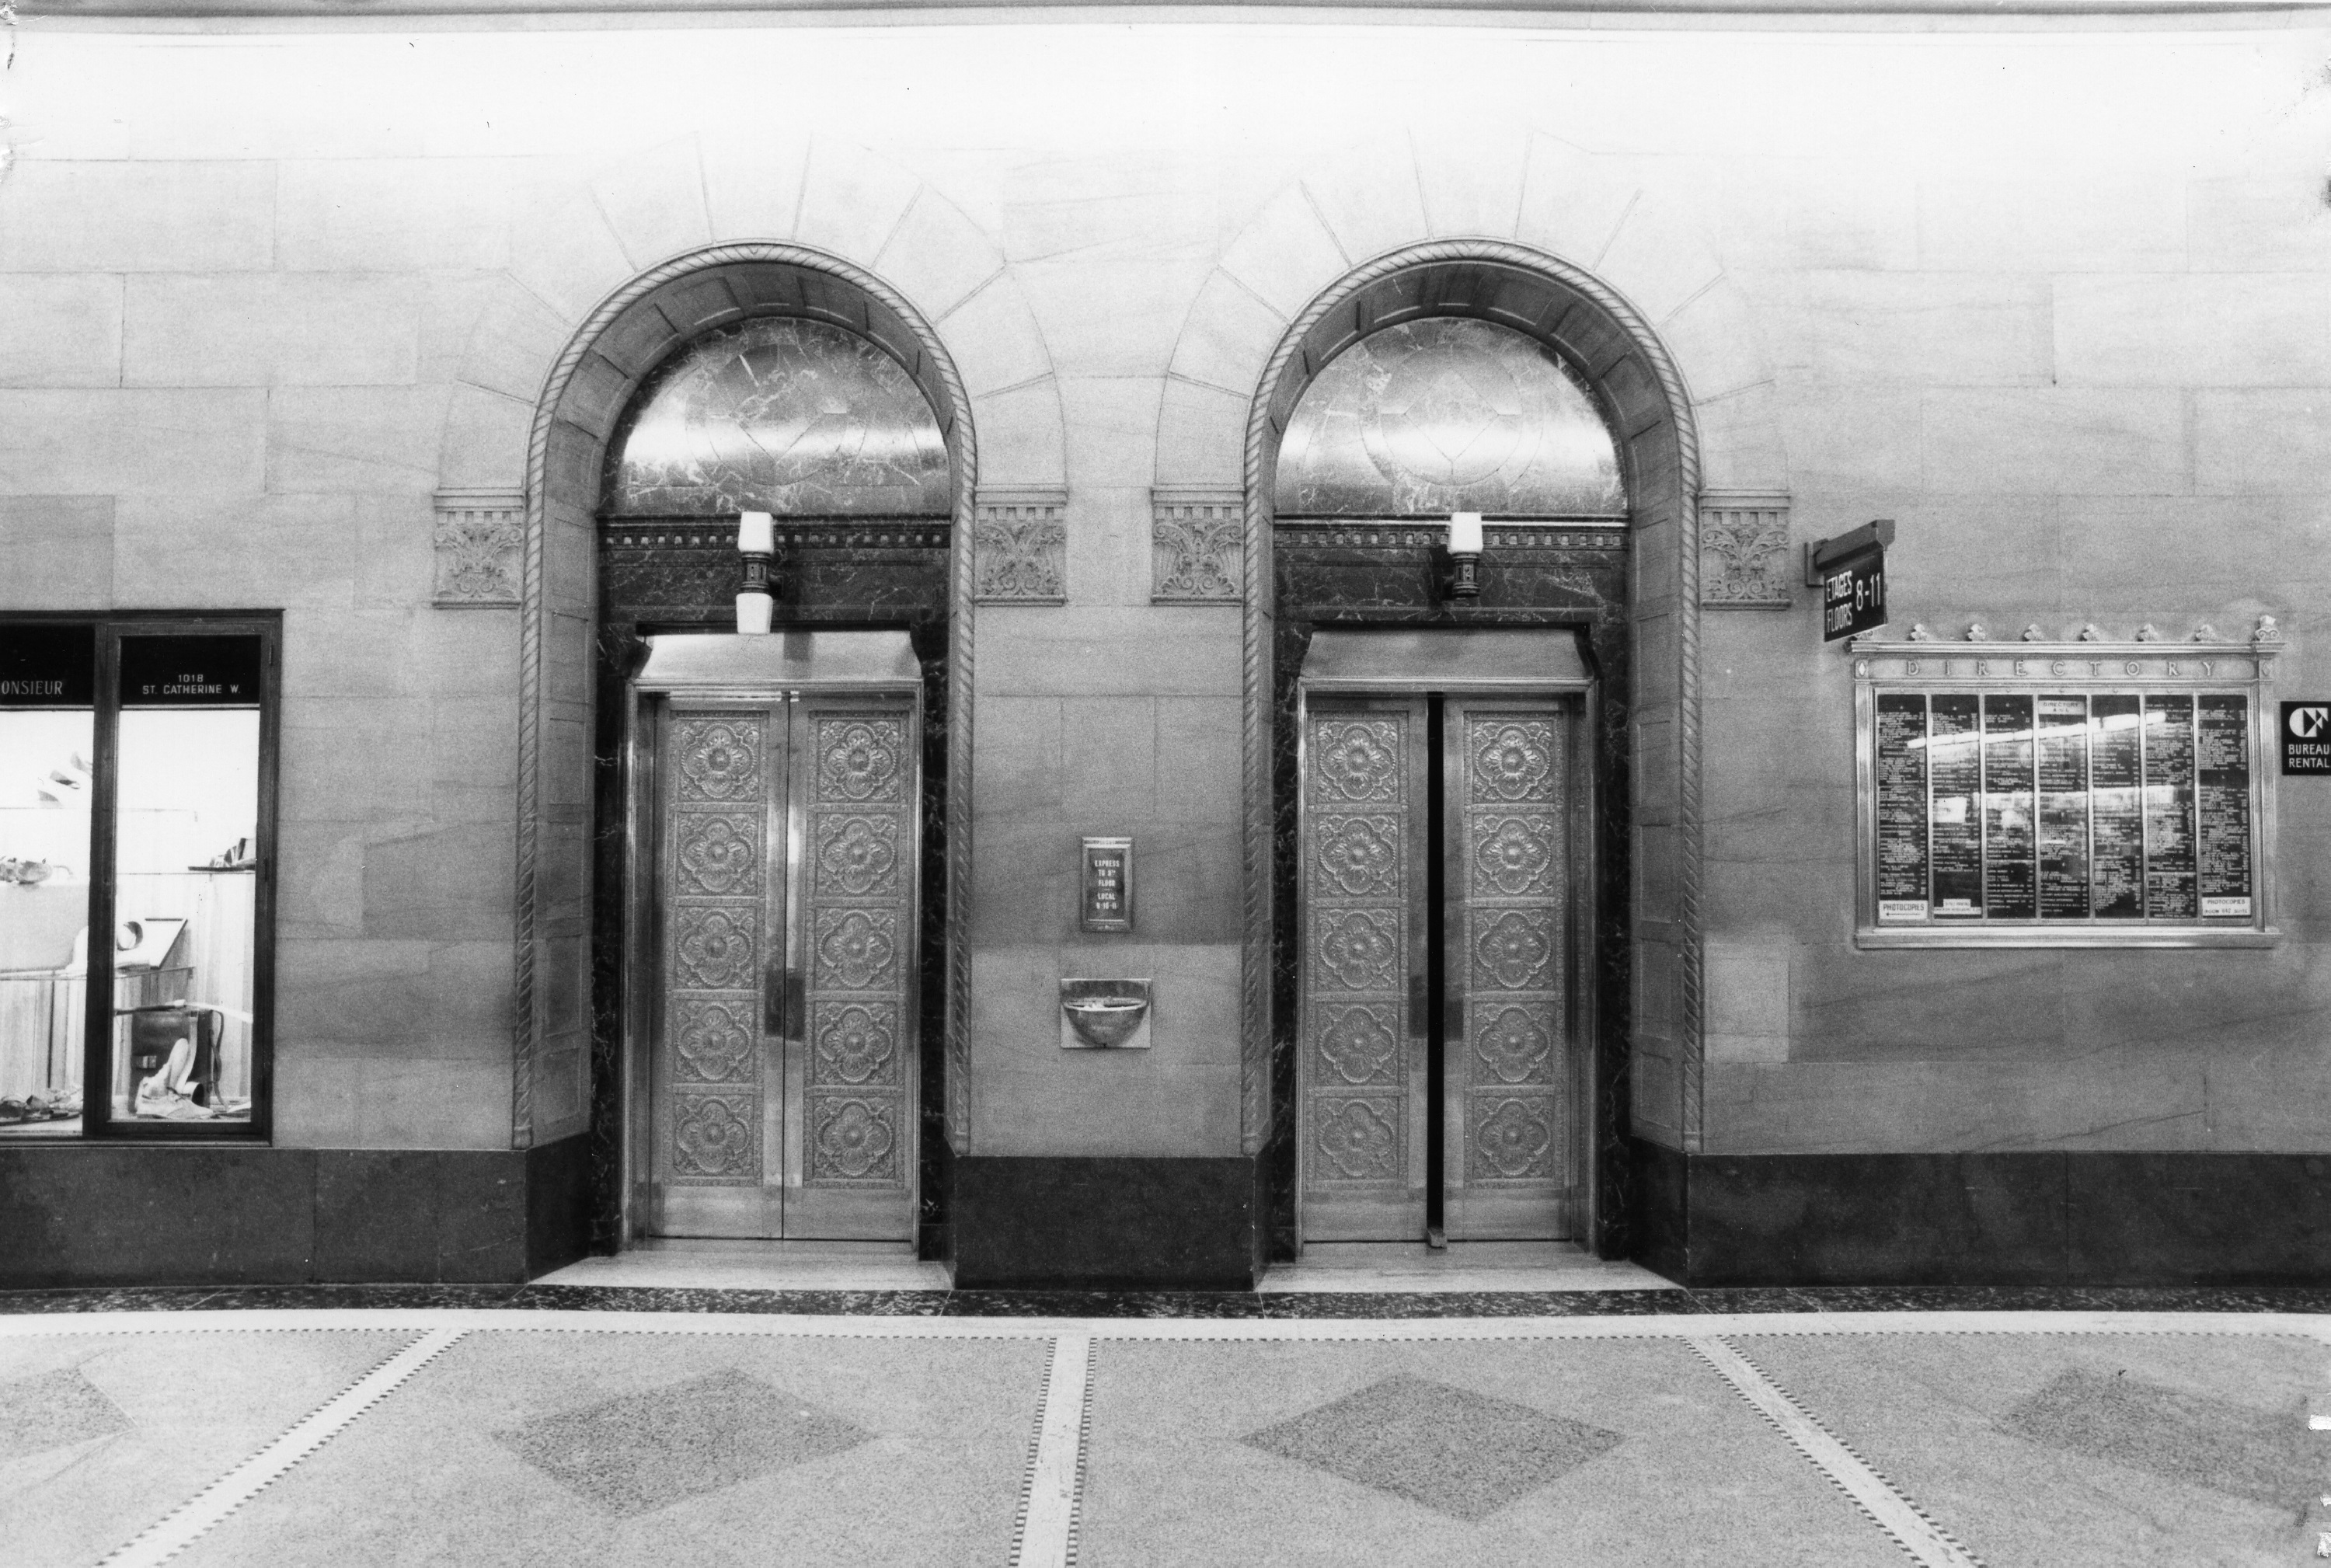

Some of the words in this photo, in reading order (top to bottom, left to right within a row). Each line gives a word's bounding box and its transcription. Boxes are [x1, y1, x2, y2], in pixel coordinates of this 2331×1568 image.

[1855, 573, 1881, 612] 8-11
[1827, 602, 1853, 633] FLOORS
[1907, 660, 2214, 676] DIRECTORY
[179, 674, 204, 683] 1018
[163, 685, 222, 694] CATHERINE
[2288, 744, 2330, 755] BUREAU
[2288, 758, 2330, 768] RENTAL
[1094, 859, 1120, 868] EXPRESS
[1098, 869, 1106, 877] TO
